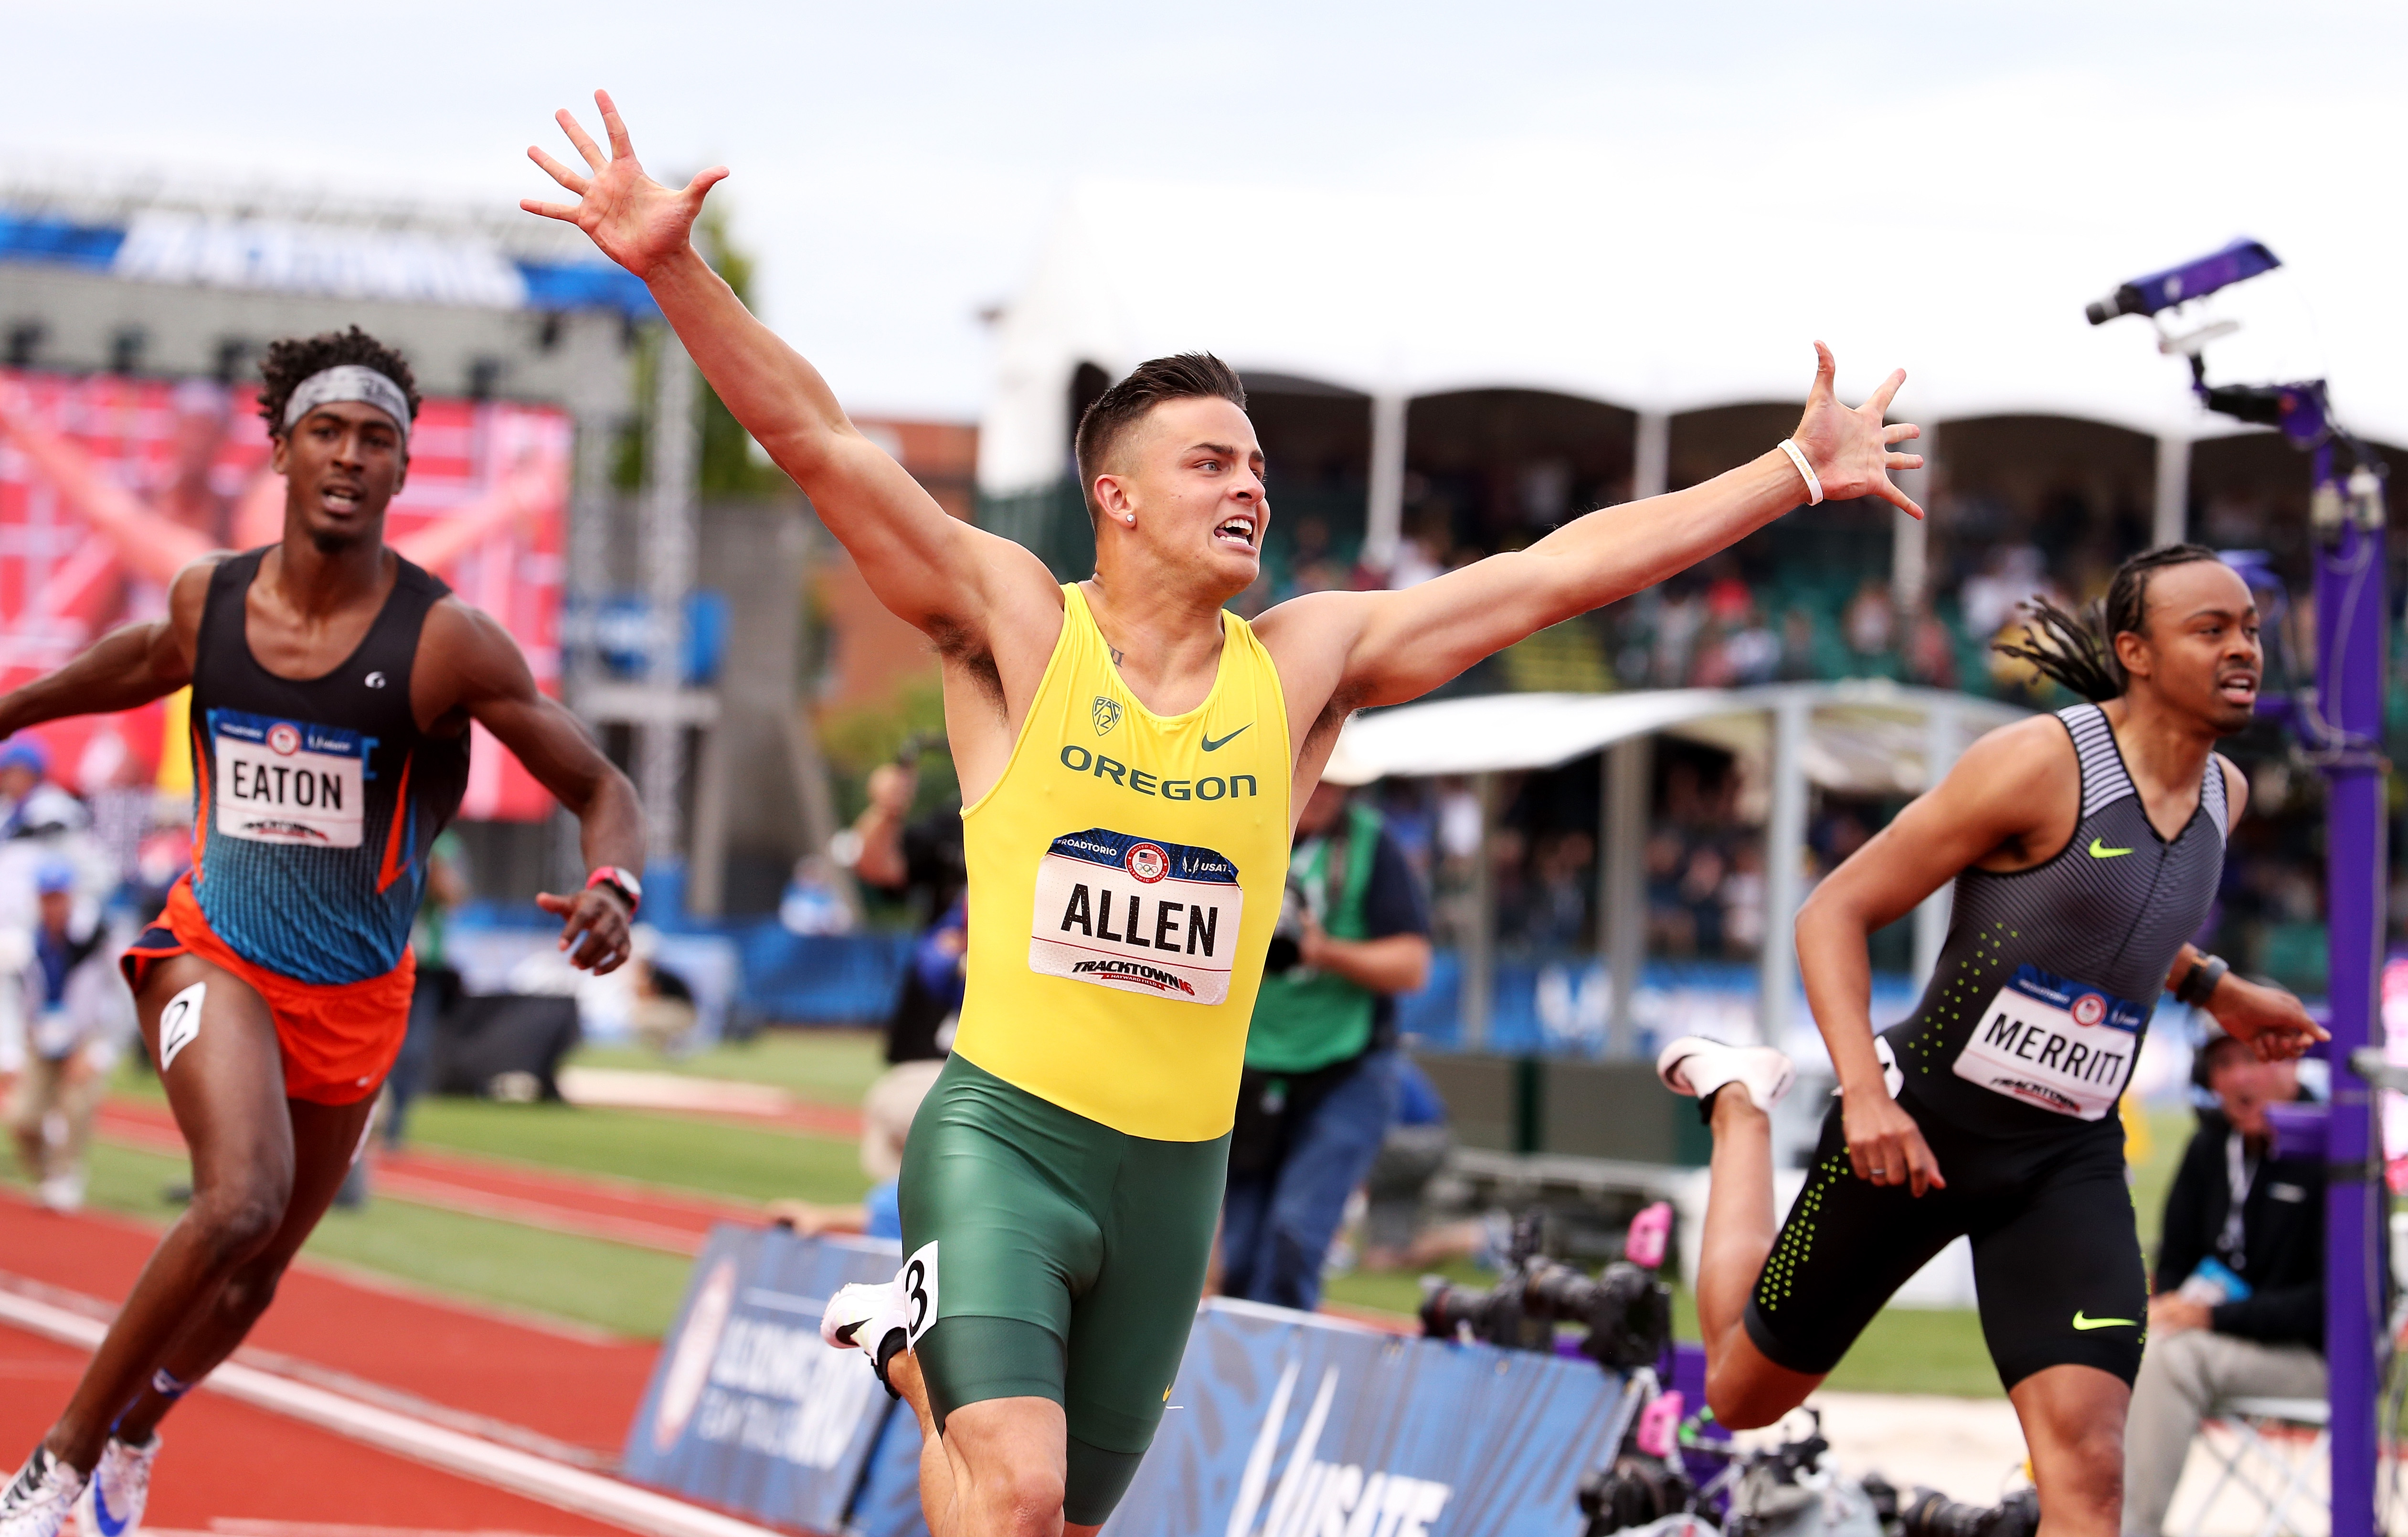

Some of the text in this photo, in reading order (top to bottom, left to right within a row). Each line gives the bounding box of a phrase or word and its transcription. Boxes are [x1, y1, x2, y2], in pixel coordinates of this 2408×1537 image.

[1094, 699, 1120, 724] PAC
[1097, 714, 1111, 729] 12
[234, 760, 341, 810] EATON
[1060, 745, 1257, 801] OREGON
[1131, 844, 1166, 859] UNITED STATES
[1201, 863, 1231, 872] USAT
[1128, 865, 1166, 883] OLYMPIC TEAM
[1060, 883, 1219, 958] ALLEN
[1142, 979, 1157, 987] FIELD
[165, 1001, 189, 1055] 2
[1984, 1012, 2125, 1086] MERRITT
[905, 1259, 928, 1338] 3
